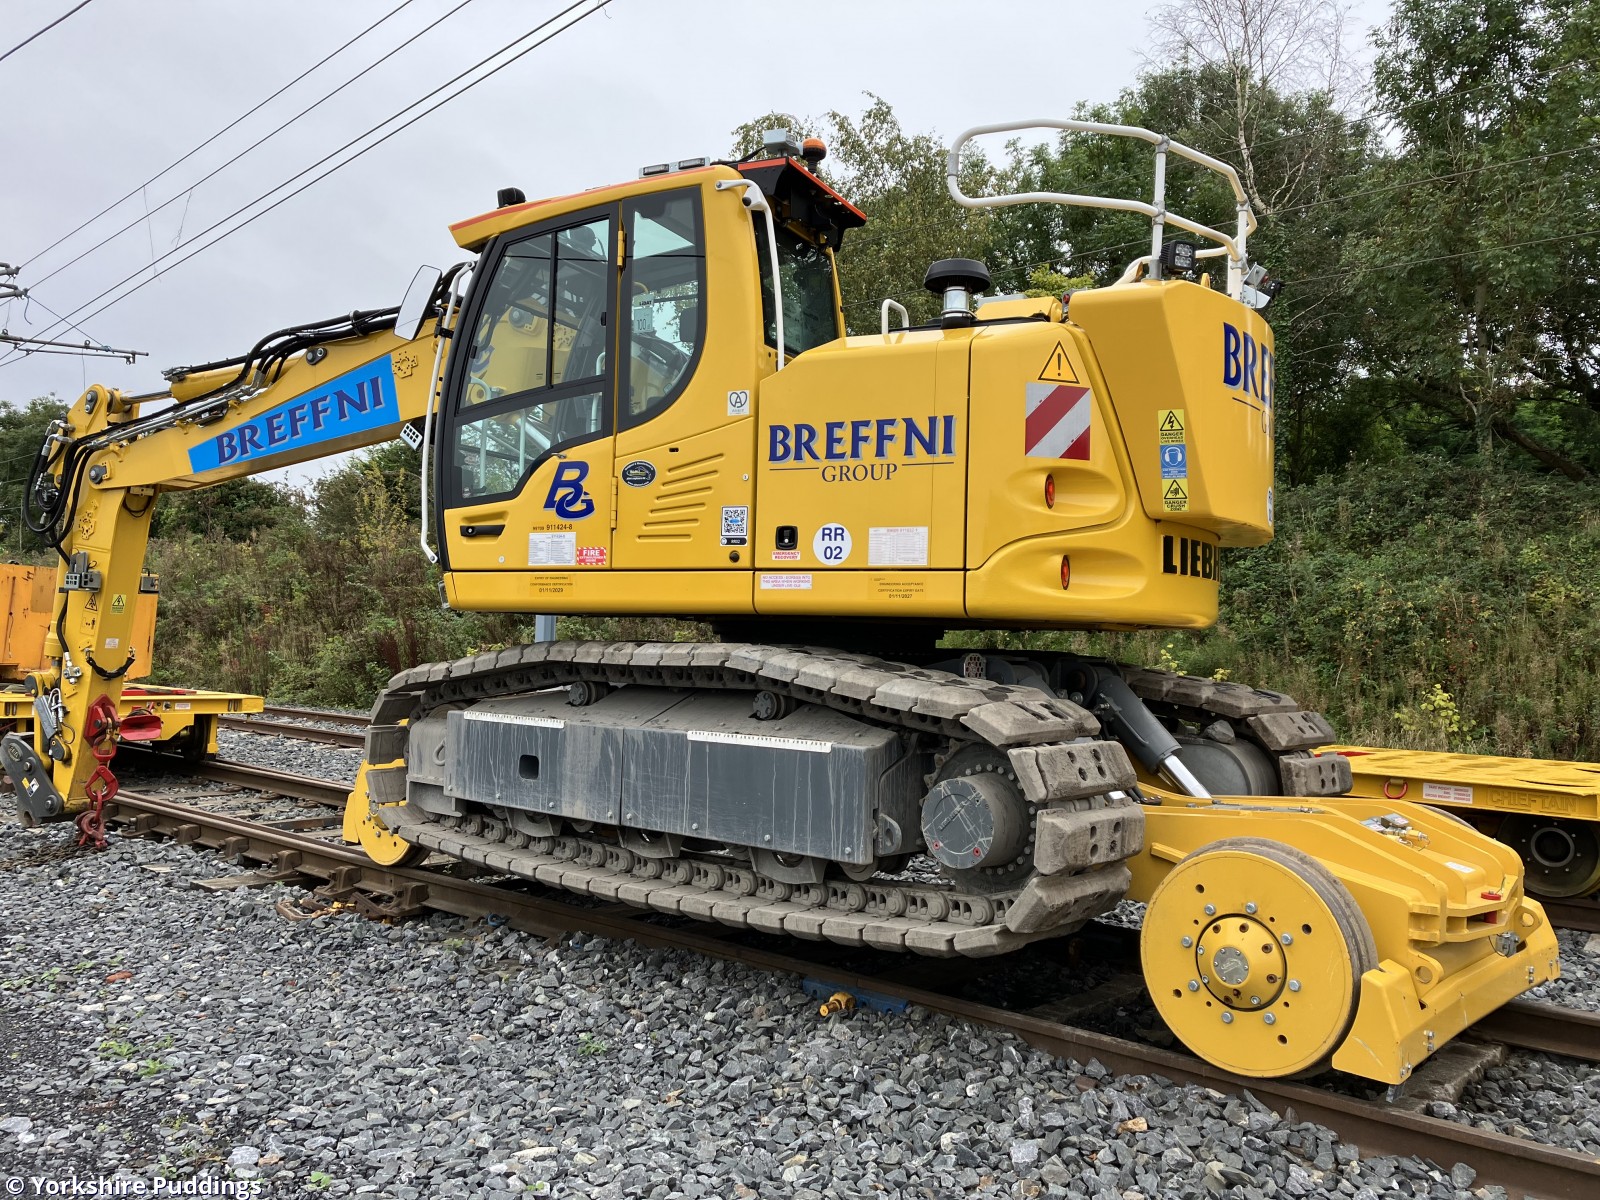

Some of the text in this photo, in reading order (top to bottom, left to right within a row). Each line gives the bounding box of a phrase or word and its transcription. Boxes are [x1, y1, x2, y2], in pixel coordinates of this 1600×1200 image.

[216, 376, 386, 465] BREFFNI
[768, 415, 956, 463] BREFFNI
[821, 463, 897, 483] GROUP
[546, 523, 573, 531] 911424-8
[821, 527, 845, 542] RR
[823, 546, 843, 560] 02
[1490, 790, 1577, 811] CHIEFTAIN
